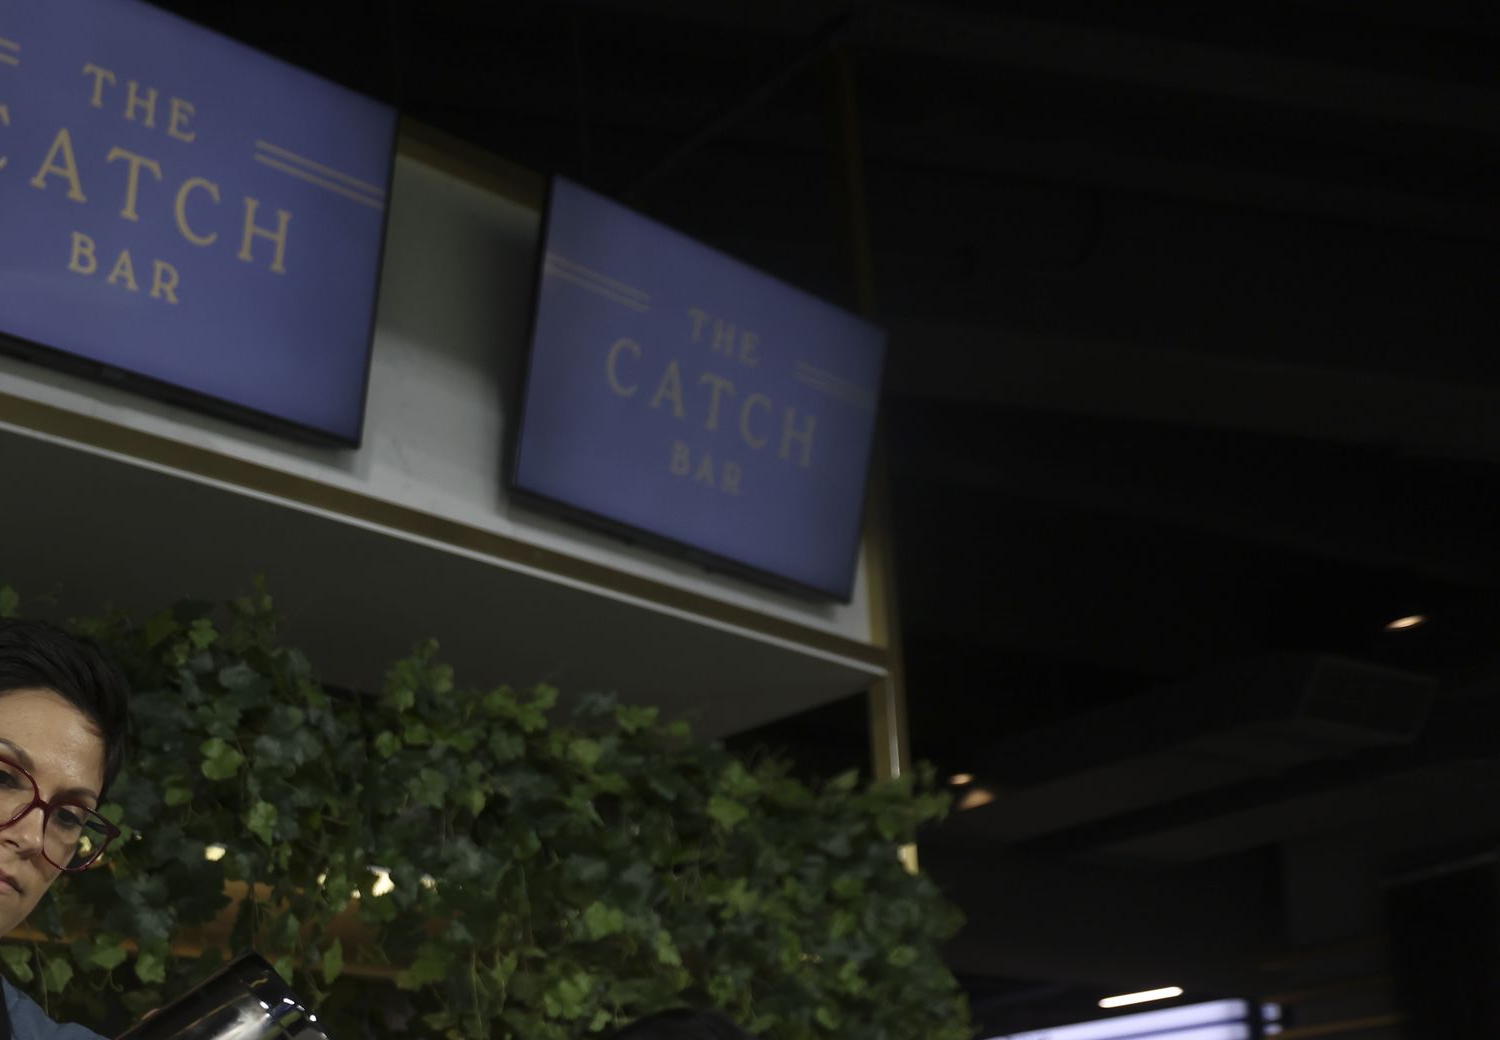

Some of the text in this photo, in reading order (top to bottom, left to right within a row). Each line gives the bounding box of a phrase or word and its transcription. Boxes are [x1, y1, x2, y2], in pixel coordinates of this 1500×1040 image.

[82, 63, 197, 143] THE
[68, 231, 180, 304] BAR
[687, 307, 760, 367] THE
[606, 338, 816, 469] CATCH
[669, 440, 742, 495] BAR
